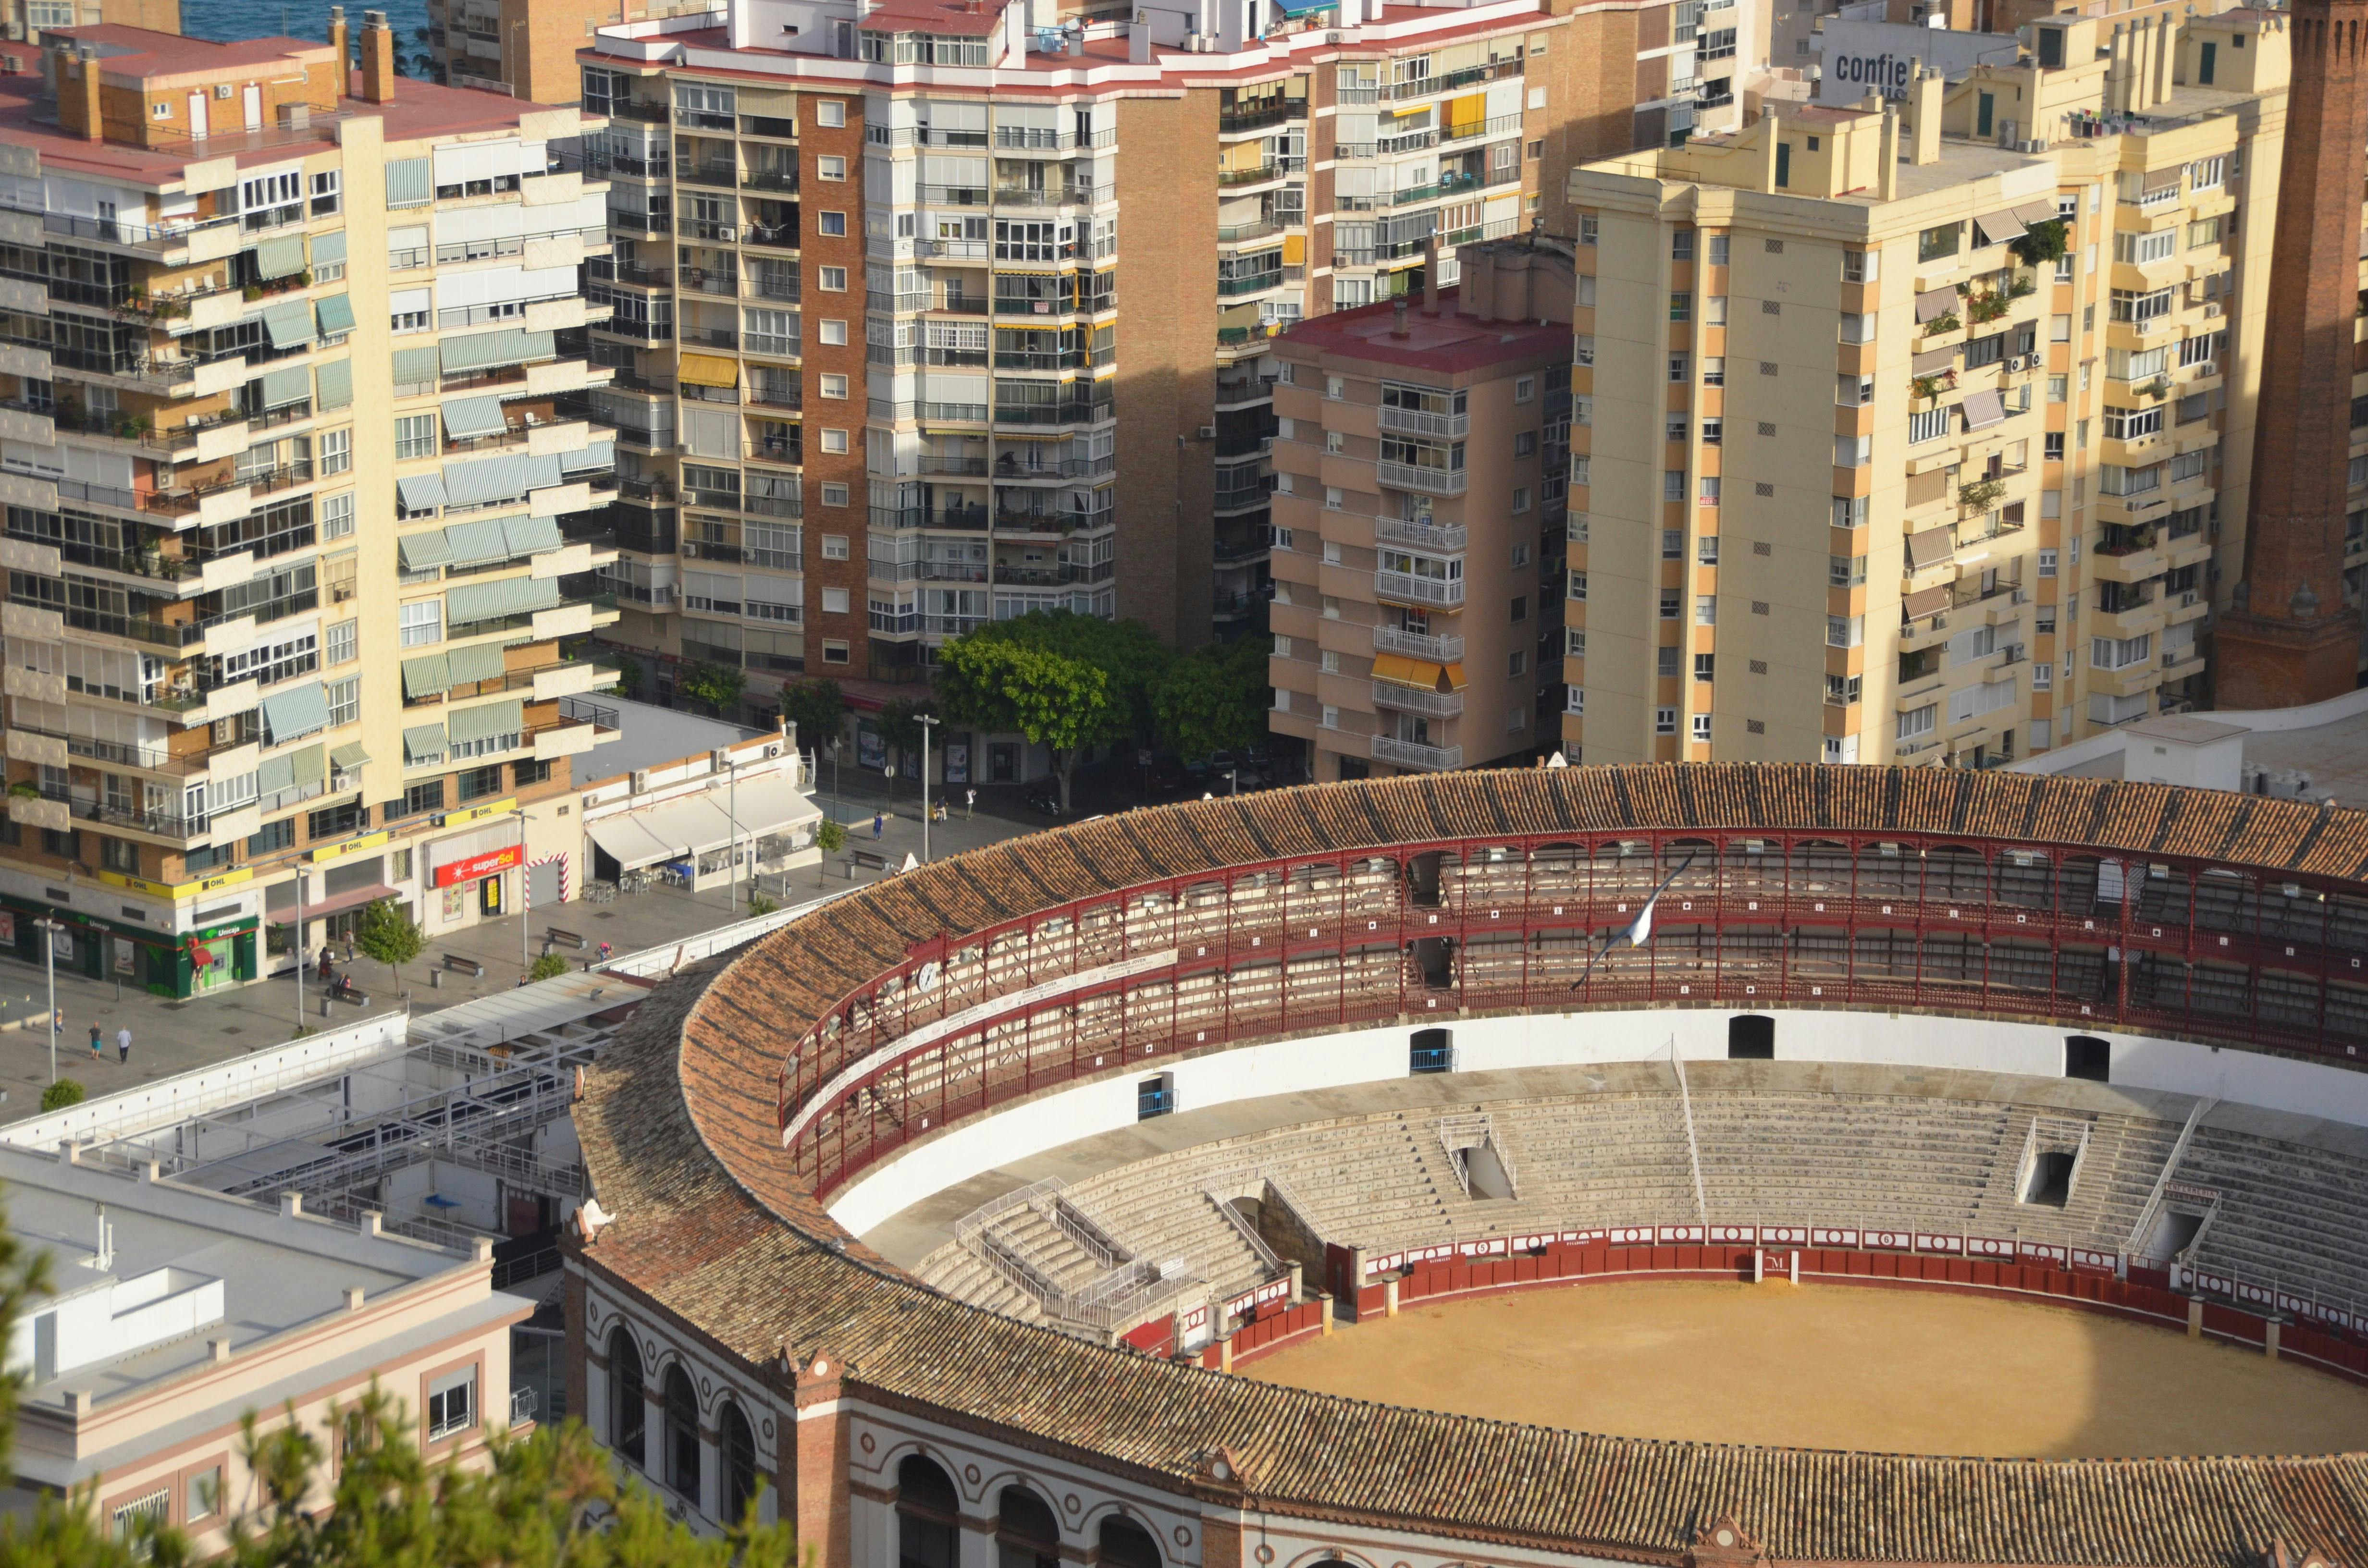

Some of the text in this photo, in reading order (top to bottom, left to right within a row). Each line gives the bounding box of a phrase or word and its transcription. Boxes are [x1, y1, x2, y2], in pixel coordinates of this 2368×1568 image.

[1837, 53, 1907, 86] confie
[479, 808, 492, 816] OHL
[348, 842, 362, 850] OHL
[472, 850, 514, 872] superSol
[134, 881, 147, 890] OHL
[210, 878, 225, 887] OHL
[89, 919, 110, 931] Unicaja
[218, 925, 240, 936] Unicaja
[1108, 962, 1131, 970] ANDANADA
[1022, 986, 1043, 994] ANDANADA
